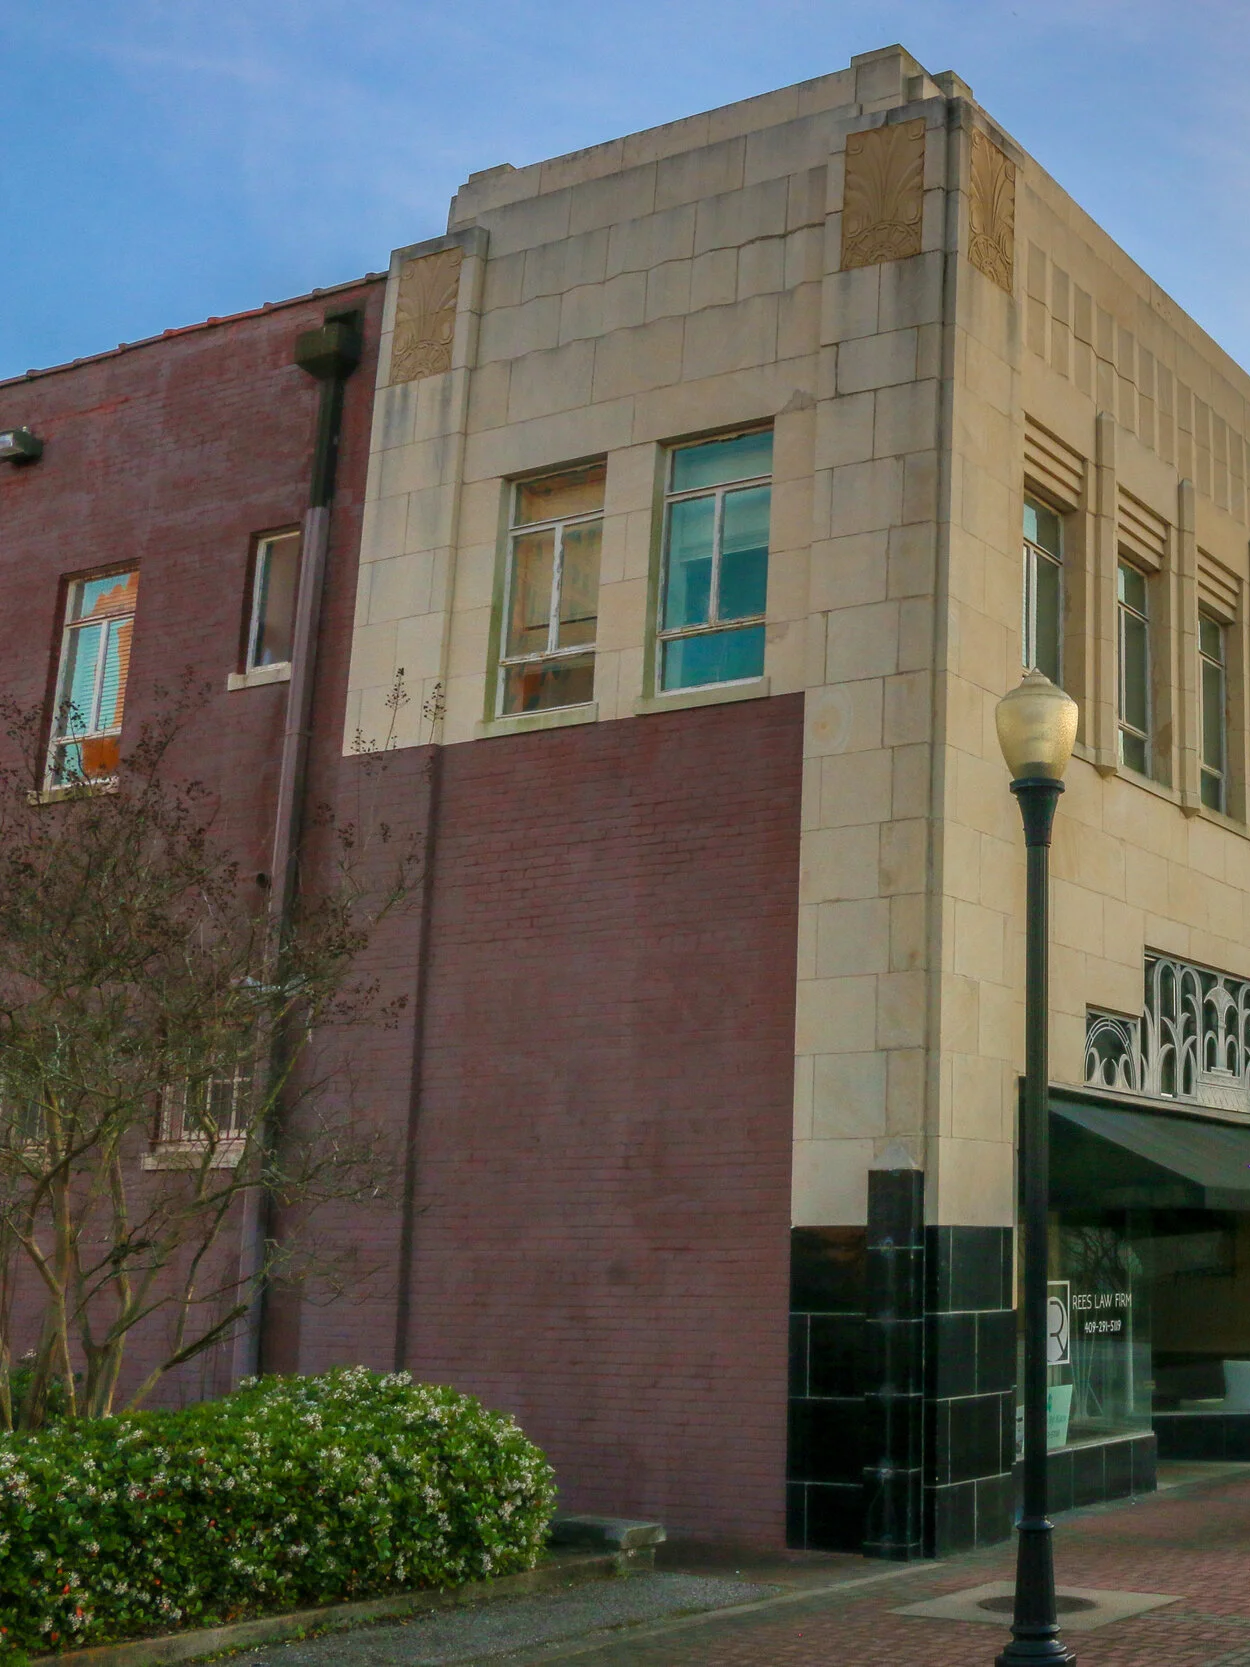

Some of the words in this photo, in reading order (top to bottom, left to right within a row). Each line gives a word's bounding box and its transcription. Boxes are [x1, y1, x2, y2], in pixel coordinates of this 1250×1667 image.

[1072, 1294, 1093, 1310] REES
[1094, 1293, 1113, 1309] LAW
[1114, 1292, 1132, 1308] FIRM
